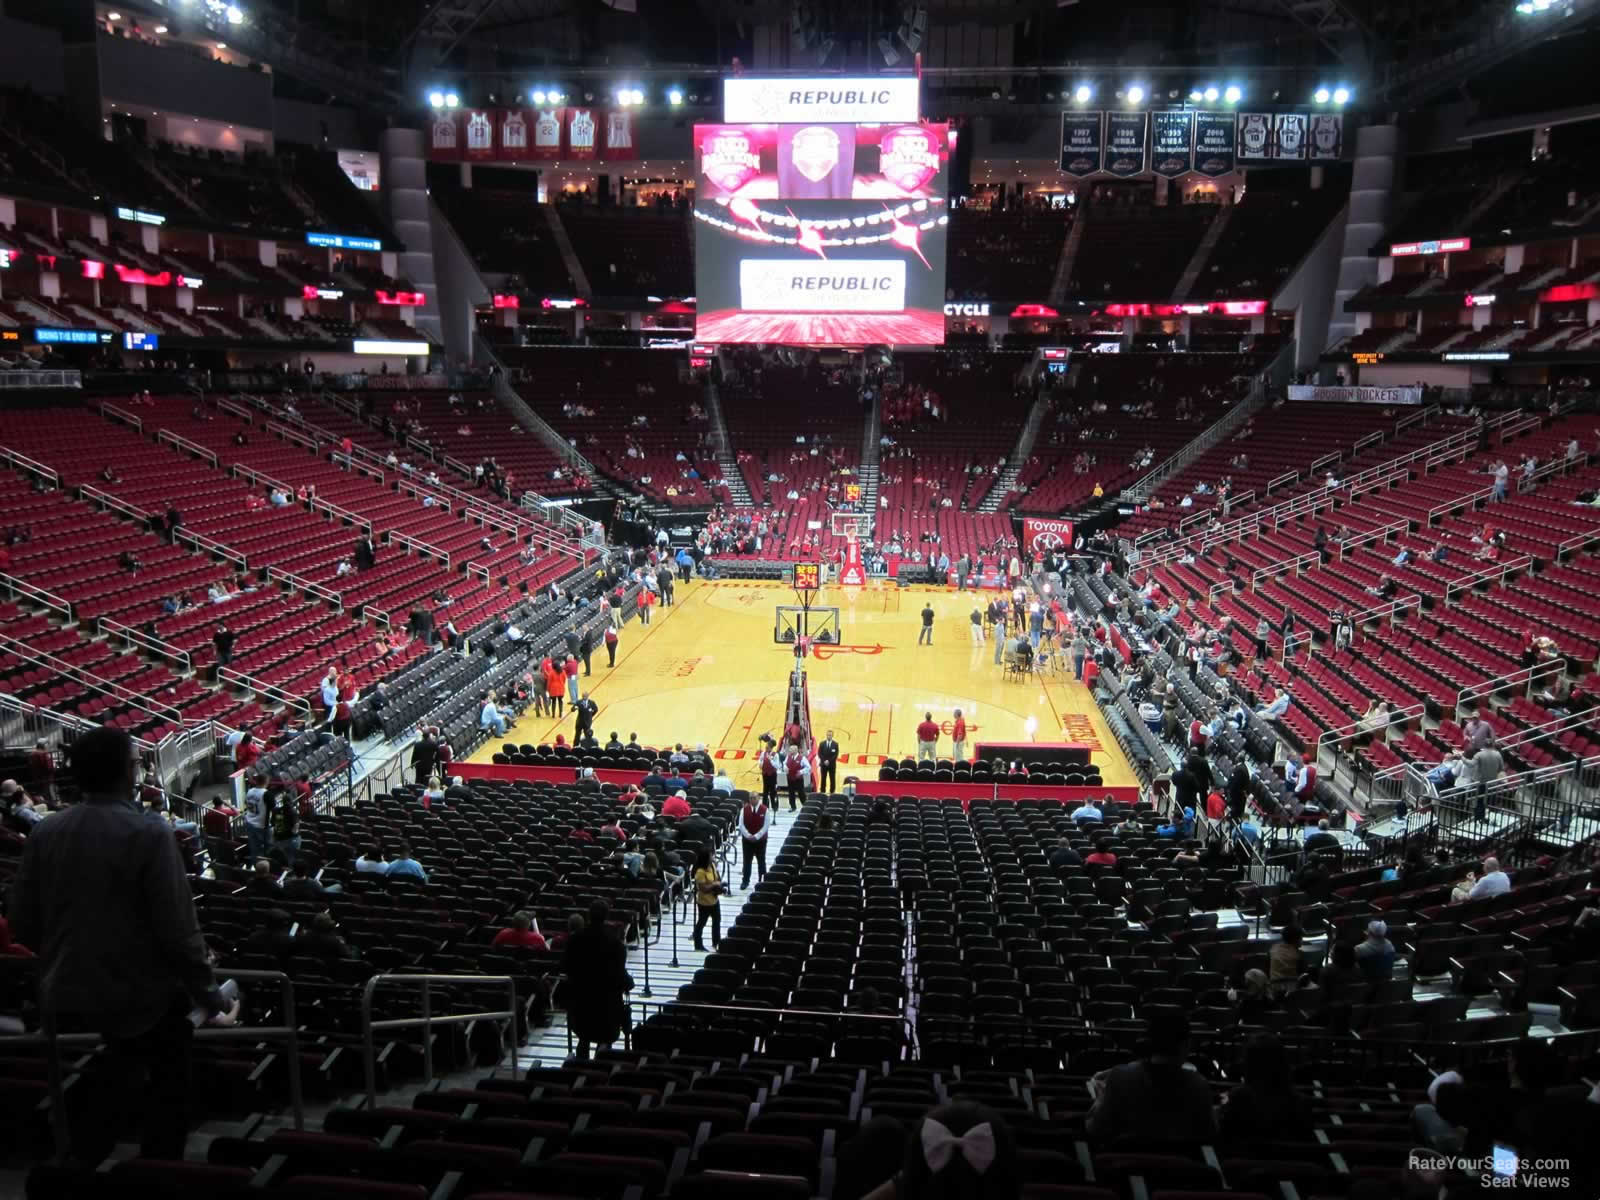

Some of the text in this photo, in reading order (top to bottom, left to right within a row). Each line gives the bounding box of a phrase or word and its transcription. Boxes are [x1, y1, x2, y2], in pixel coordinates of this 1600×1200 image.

[789, 90, 890, 105] REPUBLIC
[791, 276, 892, 291] REPUBLIC
[944, 303, 990, 316] CYCLE
[1313, 387, 1399, 402] HOUSTON ROCKETS
[1027, 520, 1069, 534] TOYOTA
[796, 565, 818, 574] 32:03
[797, 574, 818, 588] 24
